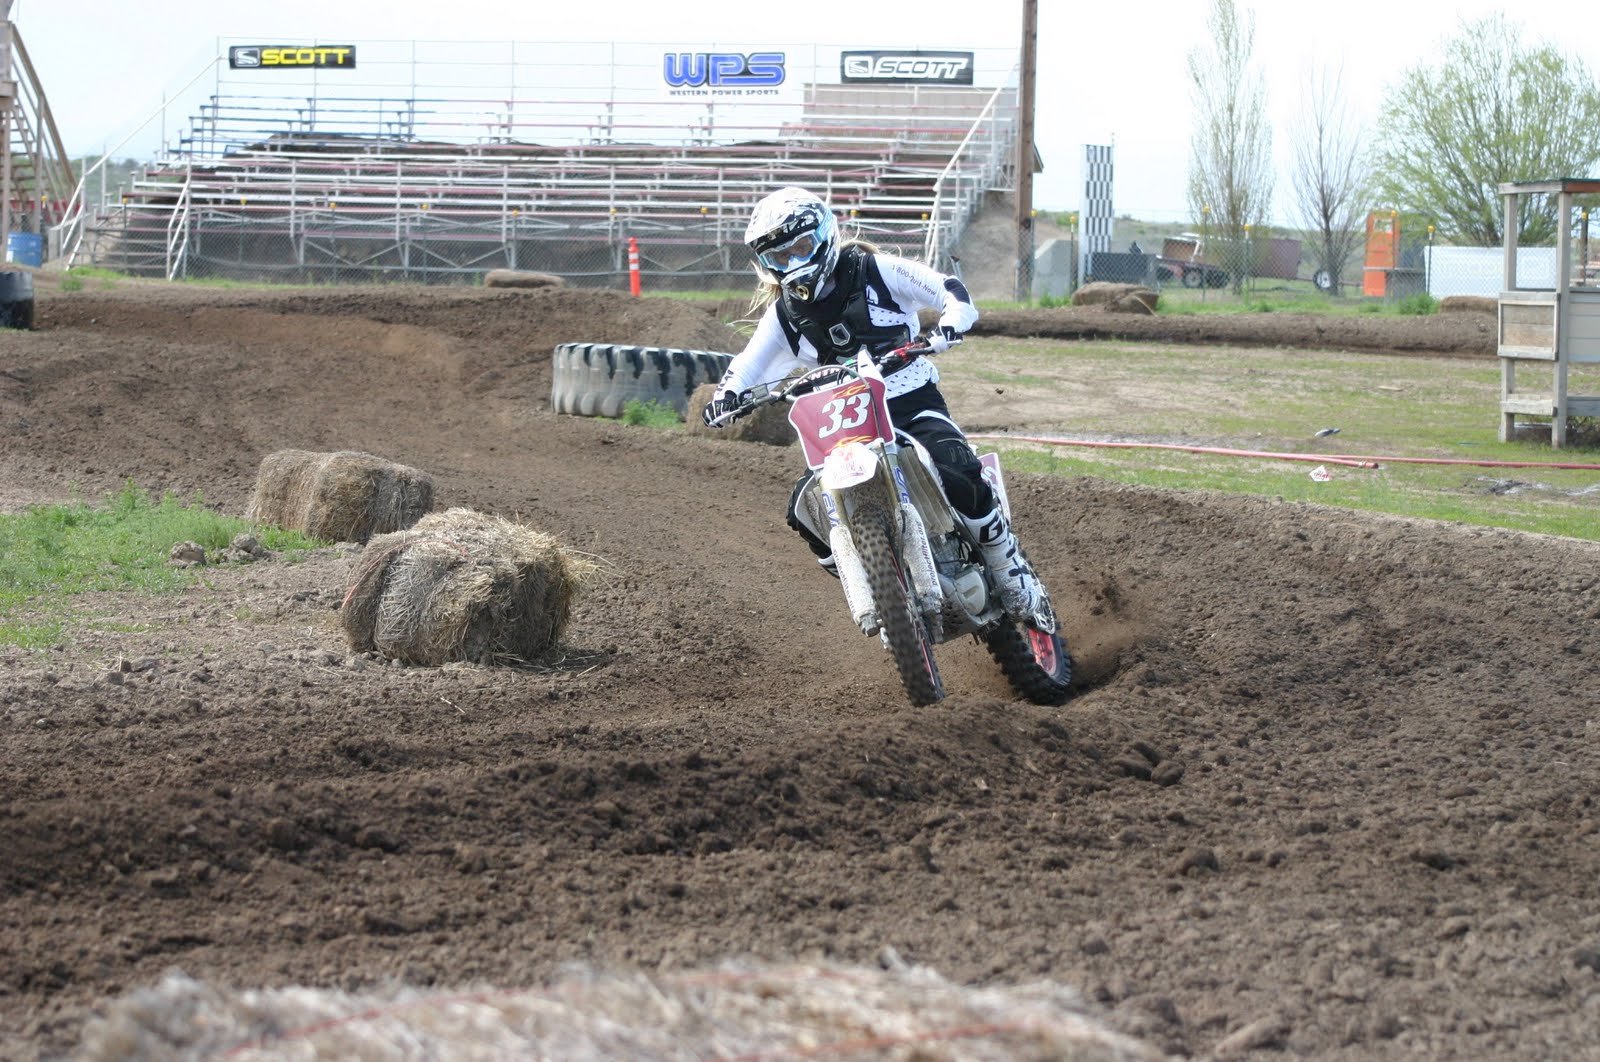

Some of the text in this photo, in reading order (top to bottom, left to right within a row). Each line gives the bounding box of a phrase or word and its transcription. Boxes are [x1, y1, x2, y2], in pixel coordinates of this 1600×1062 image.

[261, 48, 350, 65] SCOTT
[664, 52, 785, 87] WPS
[877, 60, 963, 75] SCOTT
[818, 393, 871, 439] 33
